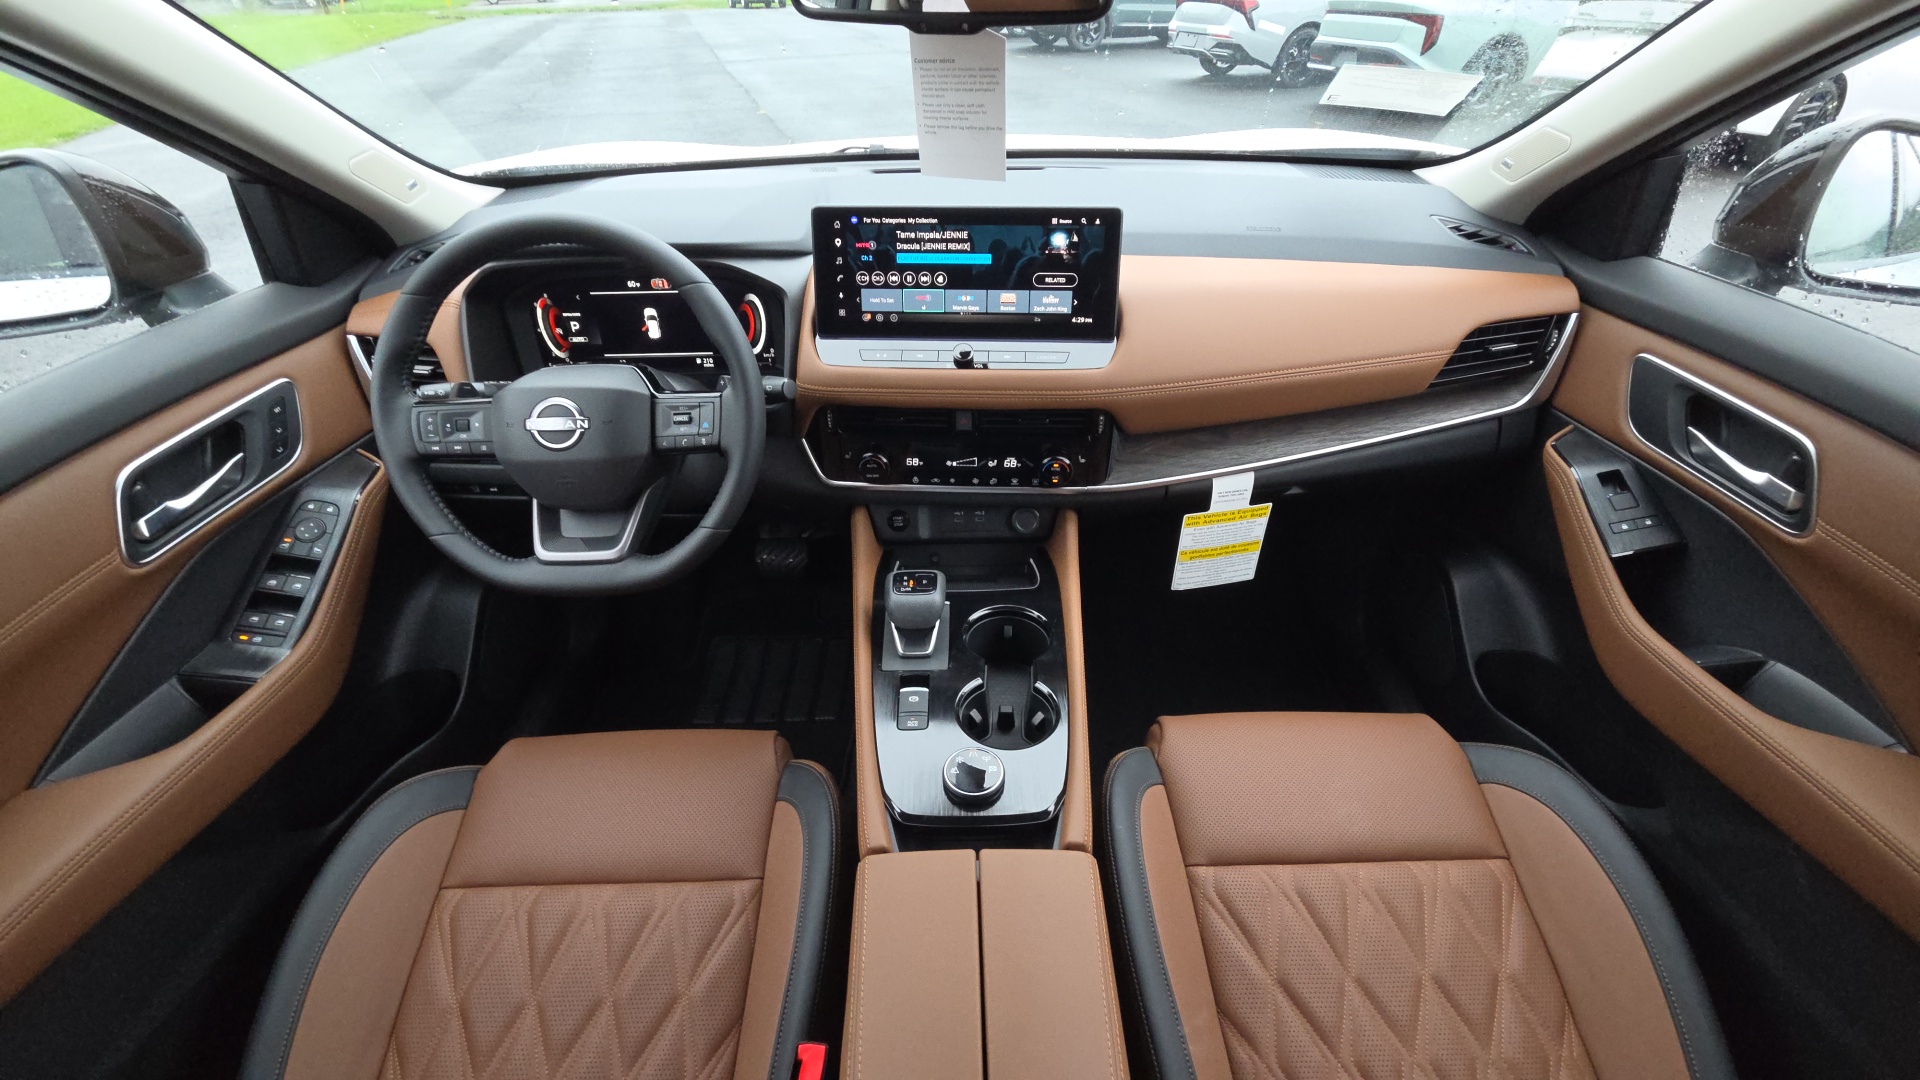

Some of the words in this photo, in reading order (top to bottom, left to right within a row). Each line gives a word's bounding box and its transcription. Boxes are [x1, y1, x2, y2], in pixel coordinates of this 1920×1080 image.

[916, 231, 968, 240] Impala/JENNIE
[570, 321, 580, 332] P
[1237, 506, 1269, 514] Equipped
